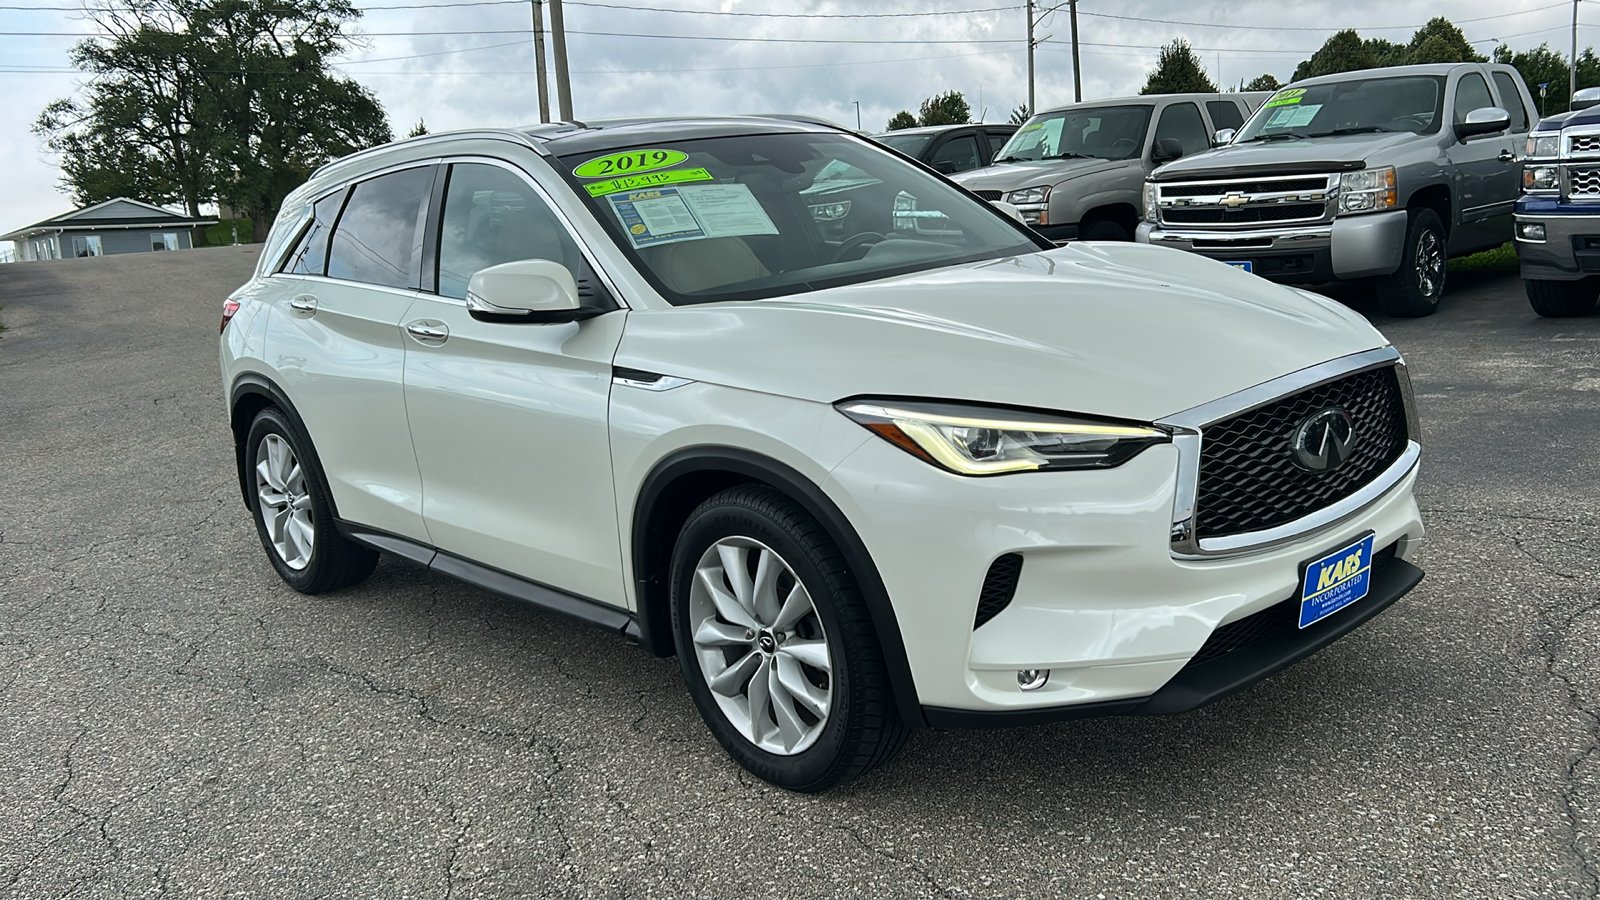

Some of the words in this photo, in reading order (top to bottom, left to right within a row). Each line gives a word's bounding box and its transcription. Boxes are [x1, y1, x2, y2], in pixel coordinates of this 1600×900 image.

[598, 151, 669, 175] 2019
[628, 190, 662, 201] KARS
[1317, 548, 1362, 591] KARS
[1311, 574, 1363, 607] INCORPORATED
